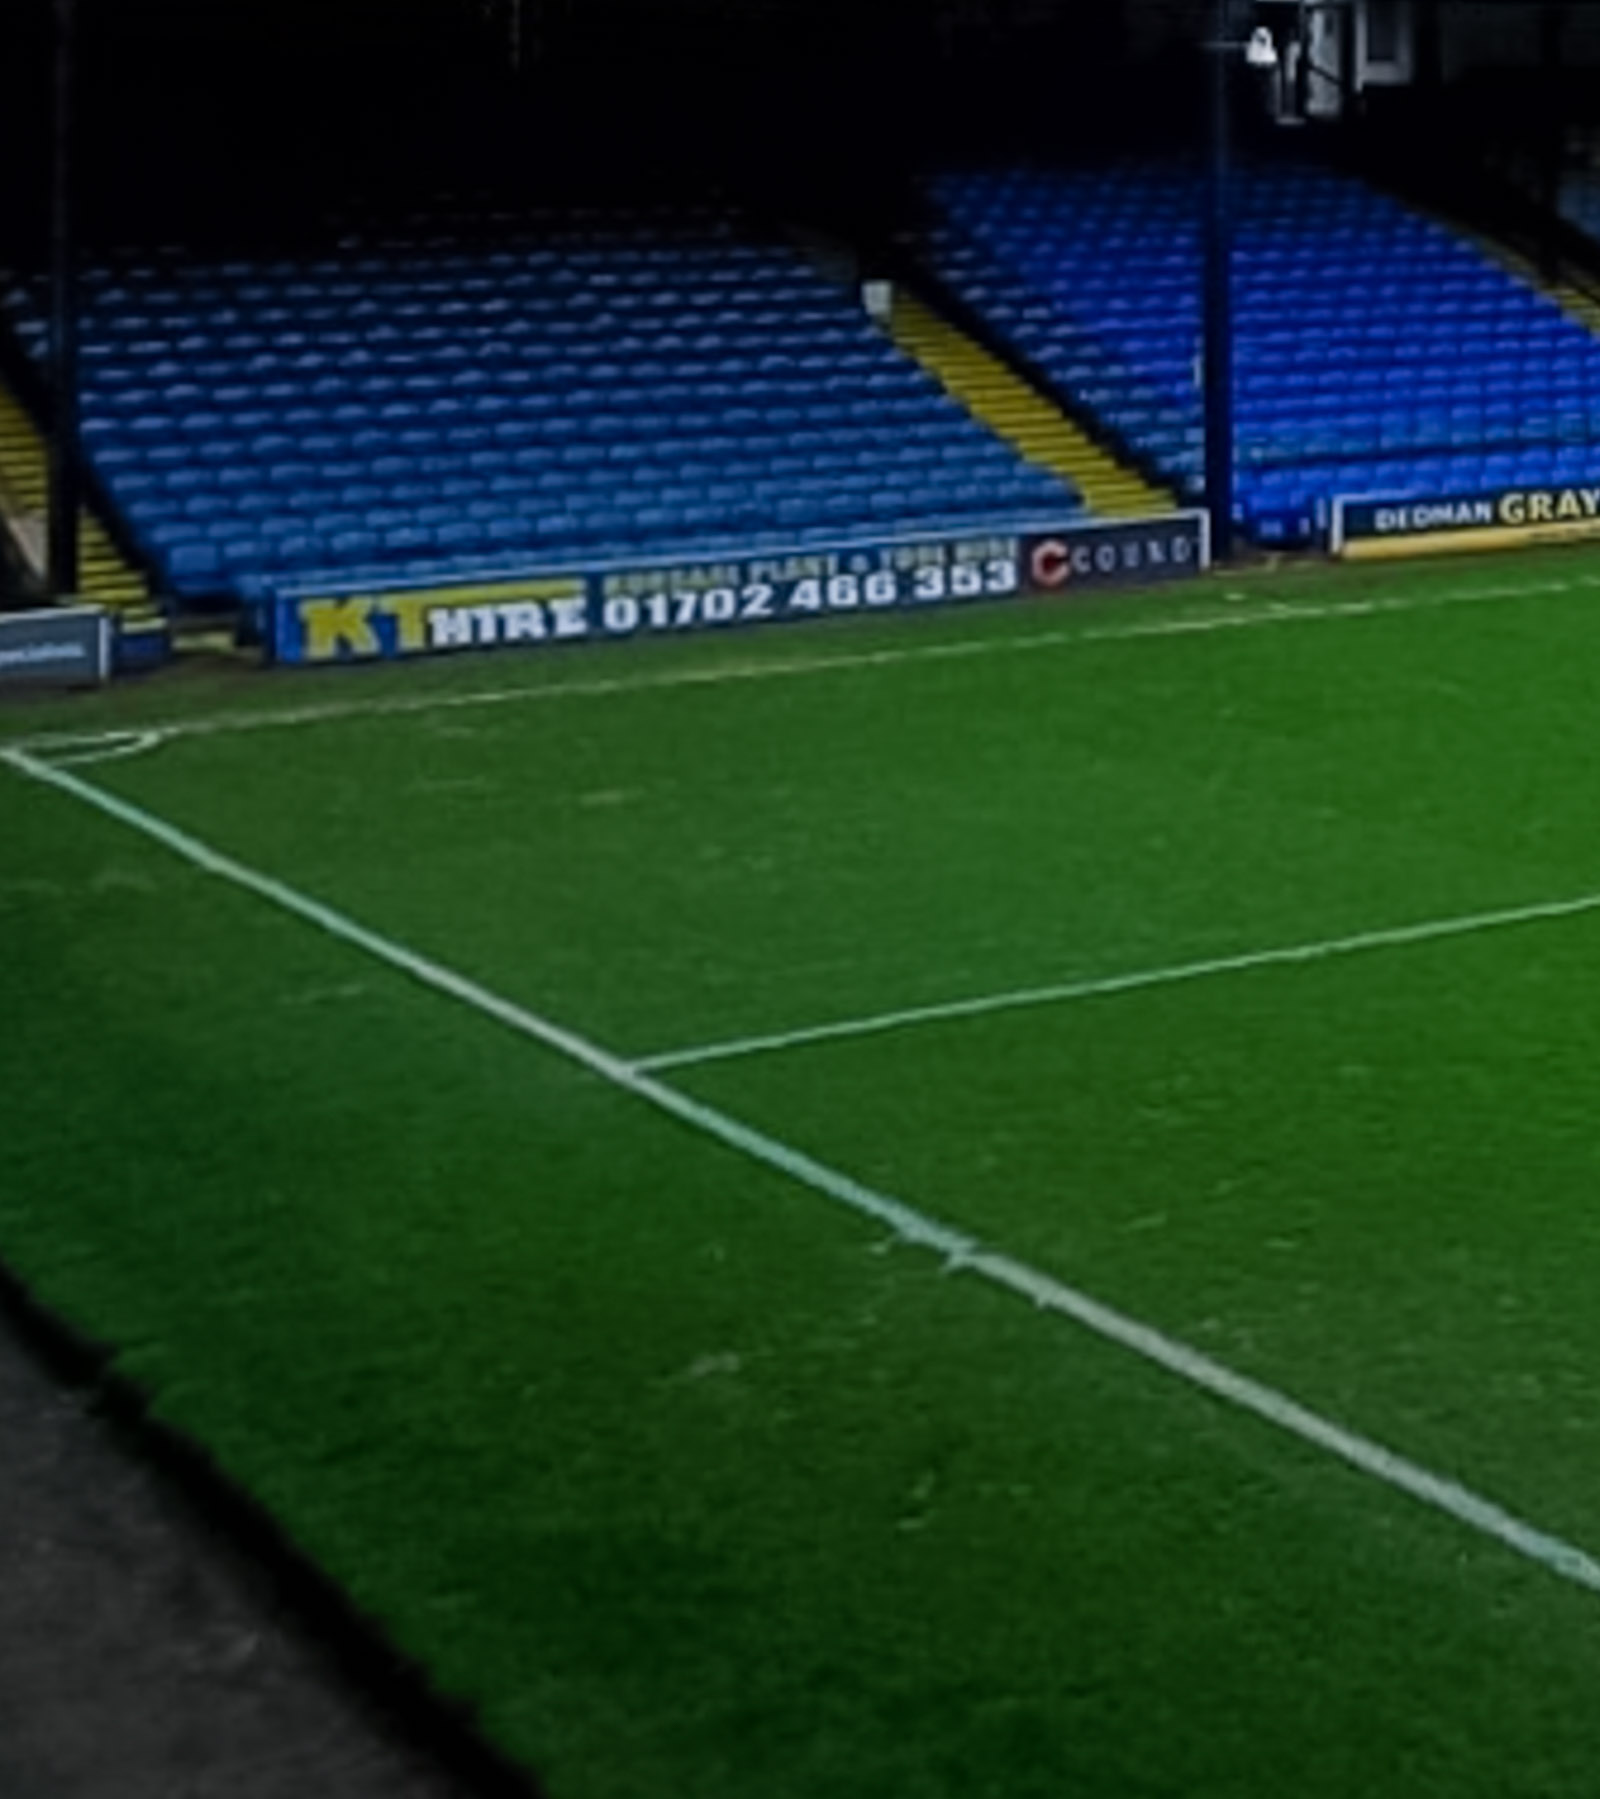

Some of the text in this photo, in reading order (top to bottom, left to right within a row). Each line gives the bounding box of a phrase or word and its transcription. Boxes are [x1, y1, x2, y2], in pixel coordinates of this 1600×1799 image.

[430, 598, 588, 649] HIRE
[602, 583, 773, 631] 01702
[786, 572, 898, 606] 466
[912, 558, 1019, 599] 353
